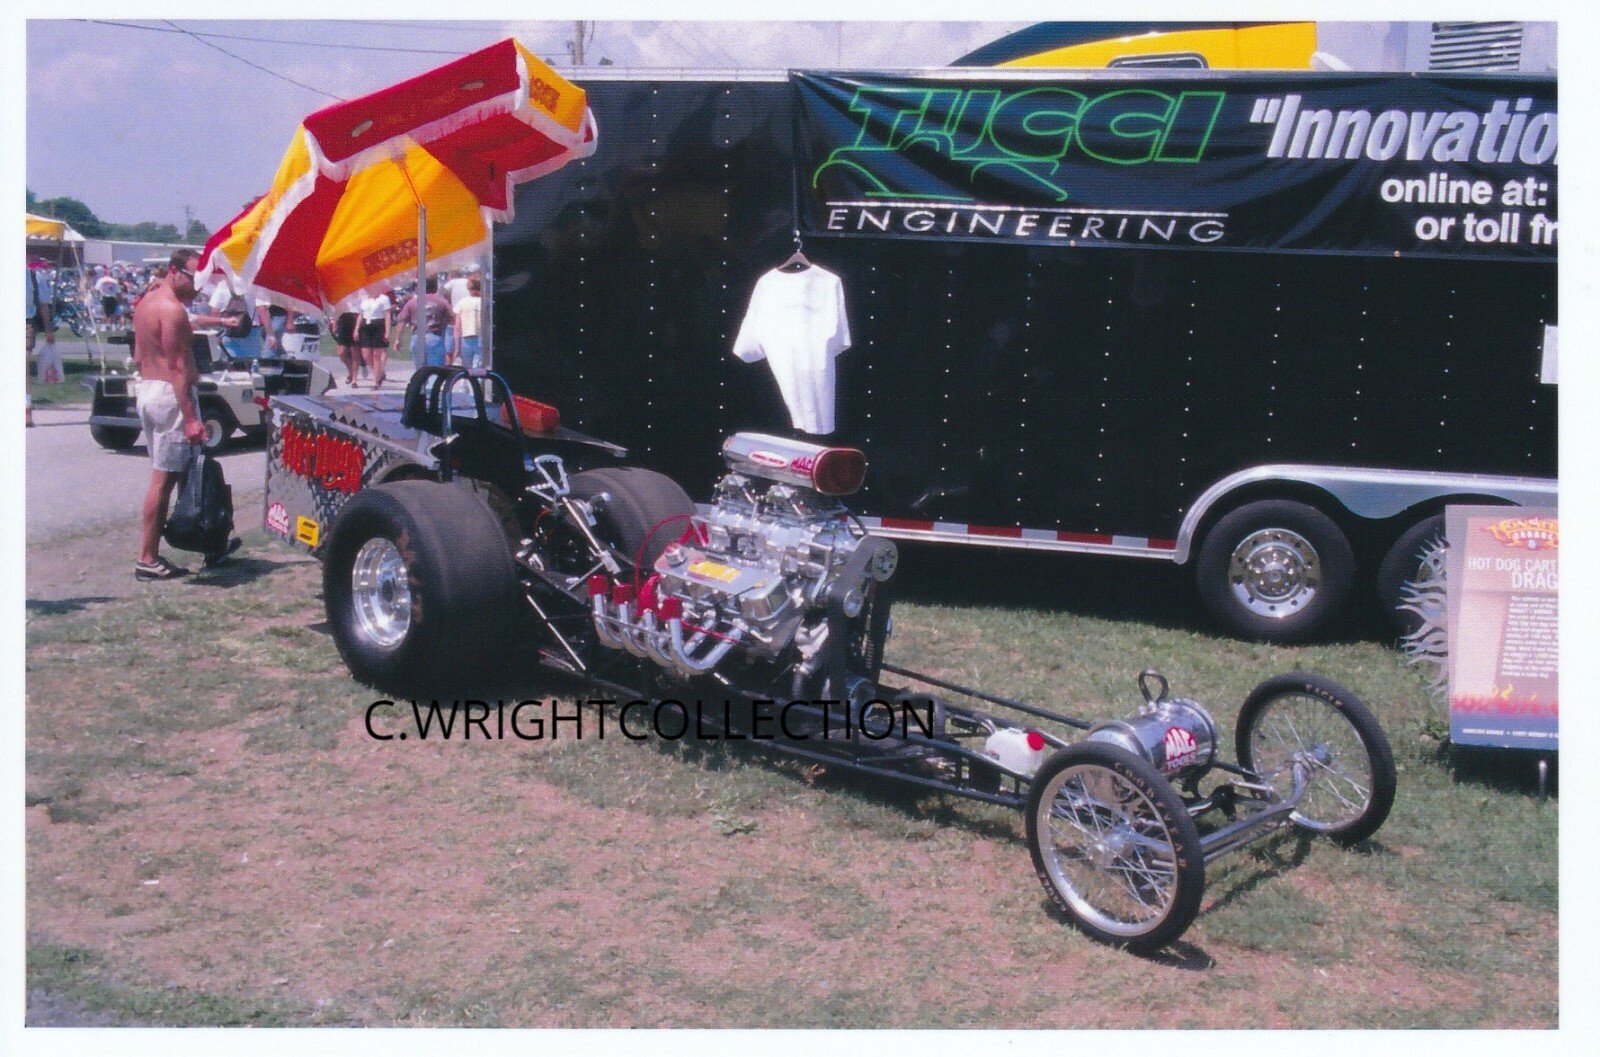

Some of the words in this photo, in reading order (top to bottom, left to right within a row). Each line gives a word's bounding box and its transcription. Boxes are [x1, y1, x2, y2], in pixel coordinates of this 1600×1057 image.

[848, 87, 1226, 164] TUCCI
[1250, 94, 1558, 165] "Innovatio
[1380, 172, 1493, 204] online
[1501, 177, 1548, 207] at:
[827, 208, 1226, 243] ENGINEERING
[1414, 216, 1456, 241] or
[1463, 212, 1520, 243] toll
[1468, 557, 1491, 570] HOT
[1496, 558, 1521, 571] DOG
[1525, 559, 1557, 572] CART
